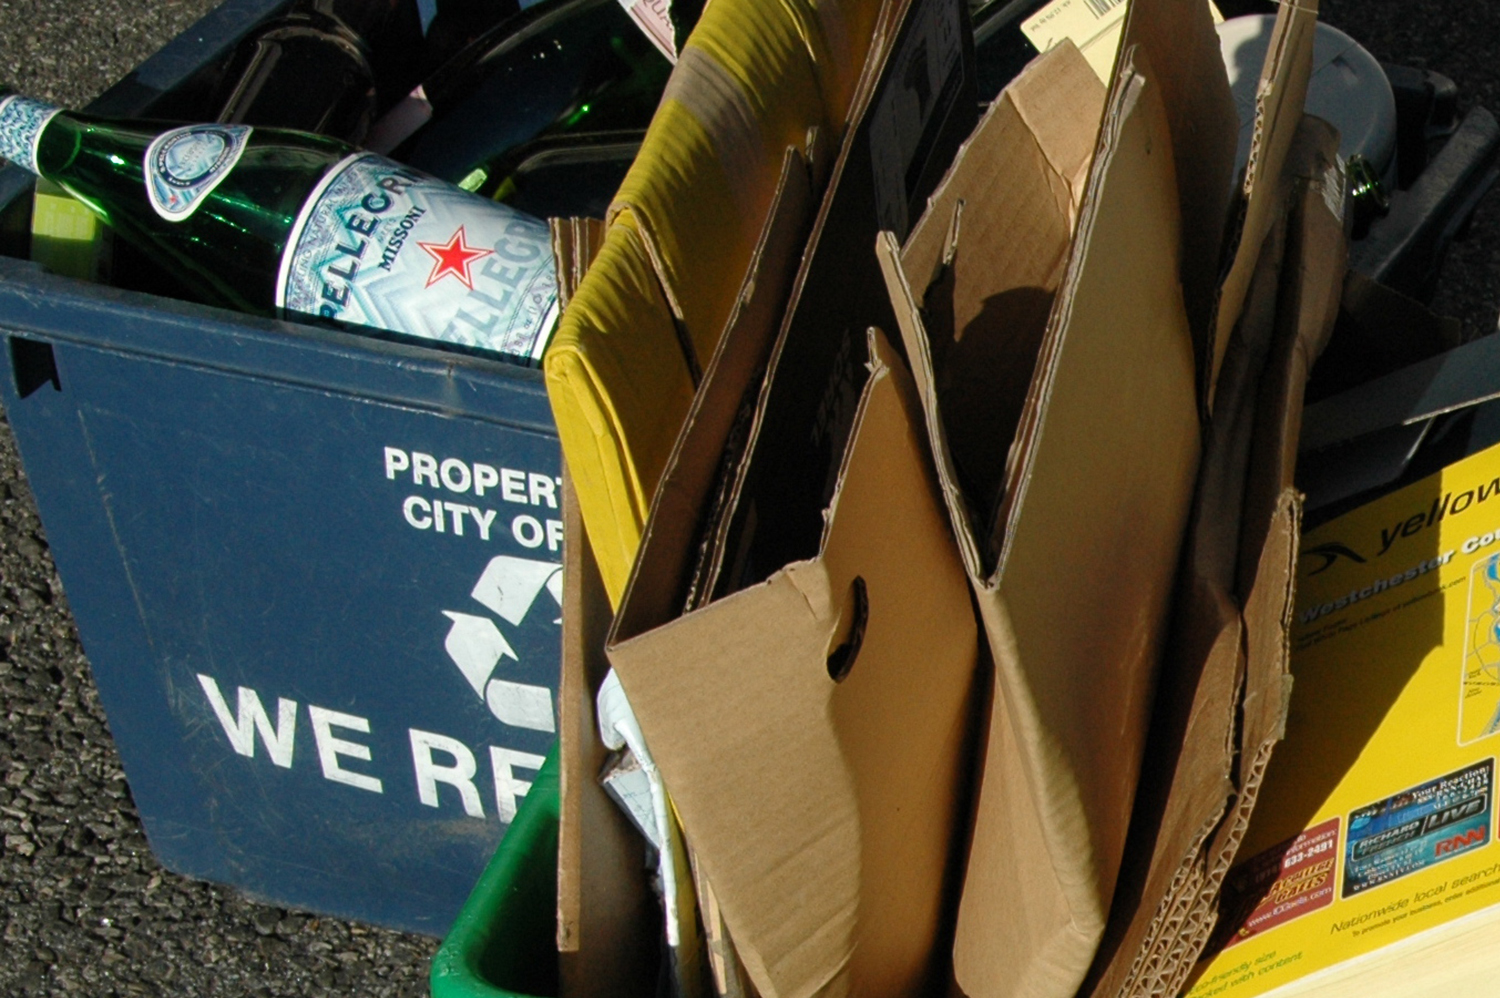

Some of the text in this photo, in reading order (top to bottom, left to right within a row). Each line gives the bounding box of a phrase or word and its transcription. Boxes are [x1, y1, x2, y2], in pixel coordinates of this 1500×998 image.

[377, 204, 427, 273] MISSONI
[402, 495, 565, 552] CITY OF
[1301, 549, 1457, 625] Westchester
[196, 672, 385, 795] WE
[1358, 820, 1420, 850] RICHARD
[1428, 799, 1482, 829] LIVE
[1434, 825, 1486, 858] RNN
[1283, 838, 1334, 869] 633-2491
[1329, 897, 1410, 935] Nationwide
[1413, 881, 1449, 904] local
[1361, 918, 1391, 936] promote
[1391, 911, 1409, 925] your
[1230, 970, 1255, 988] with
[1257, 950, 1304, 977] content
